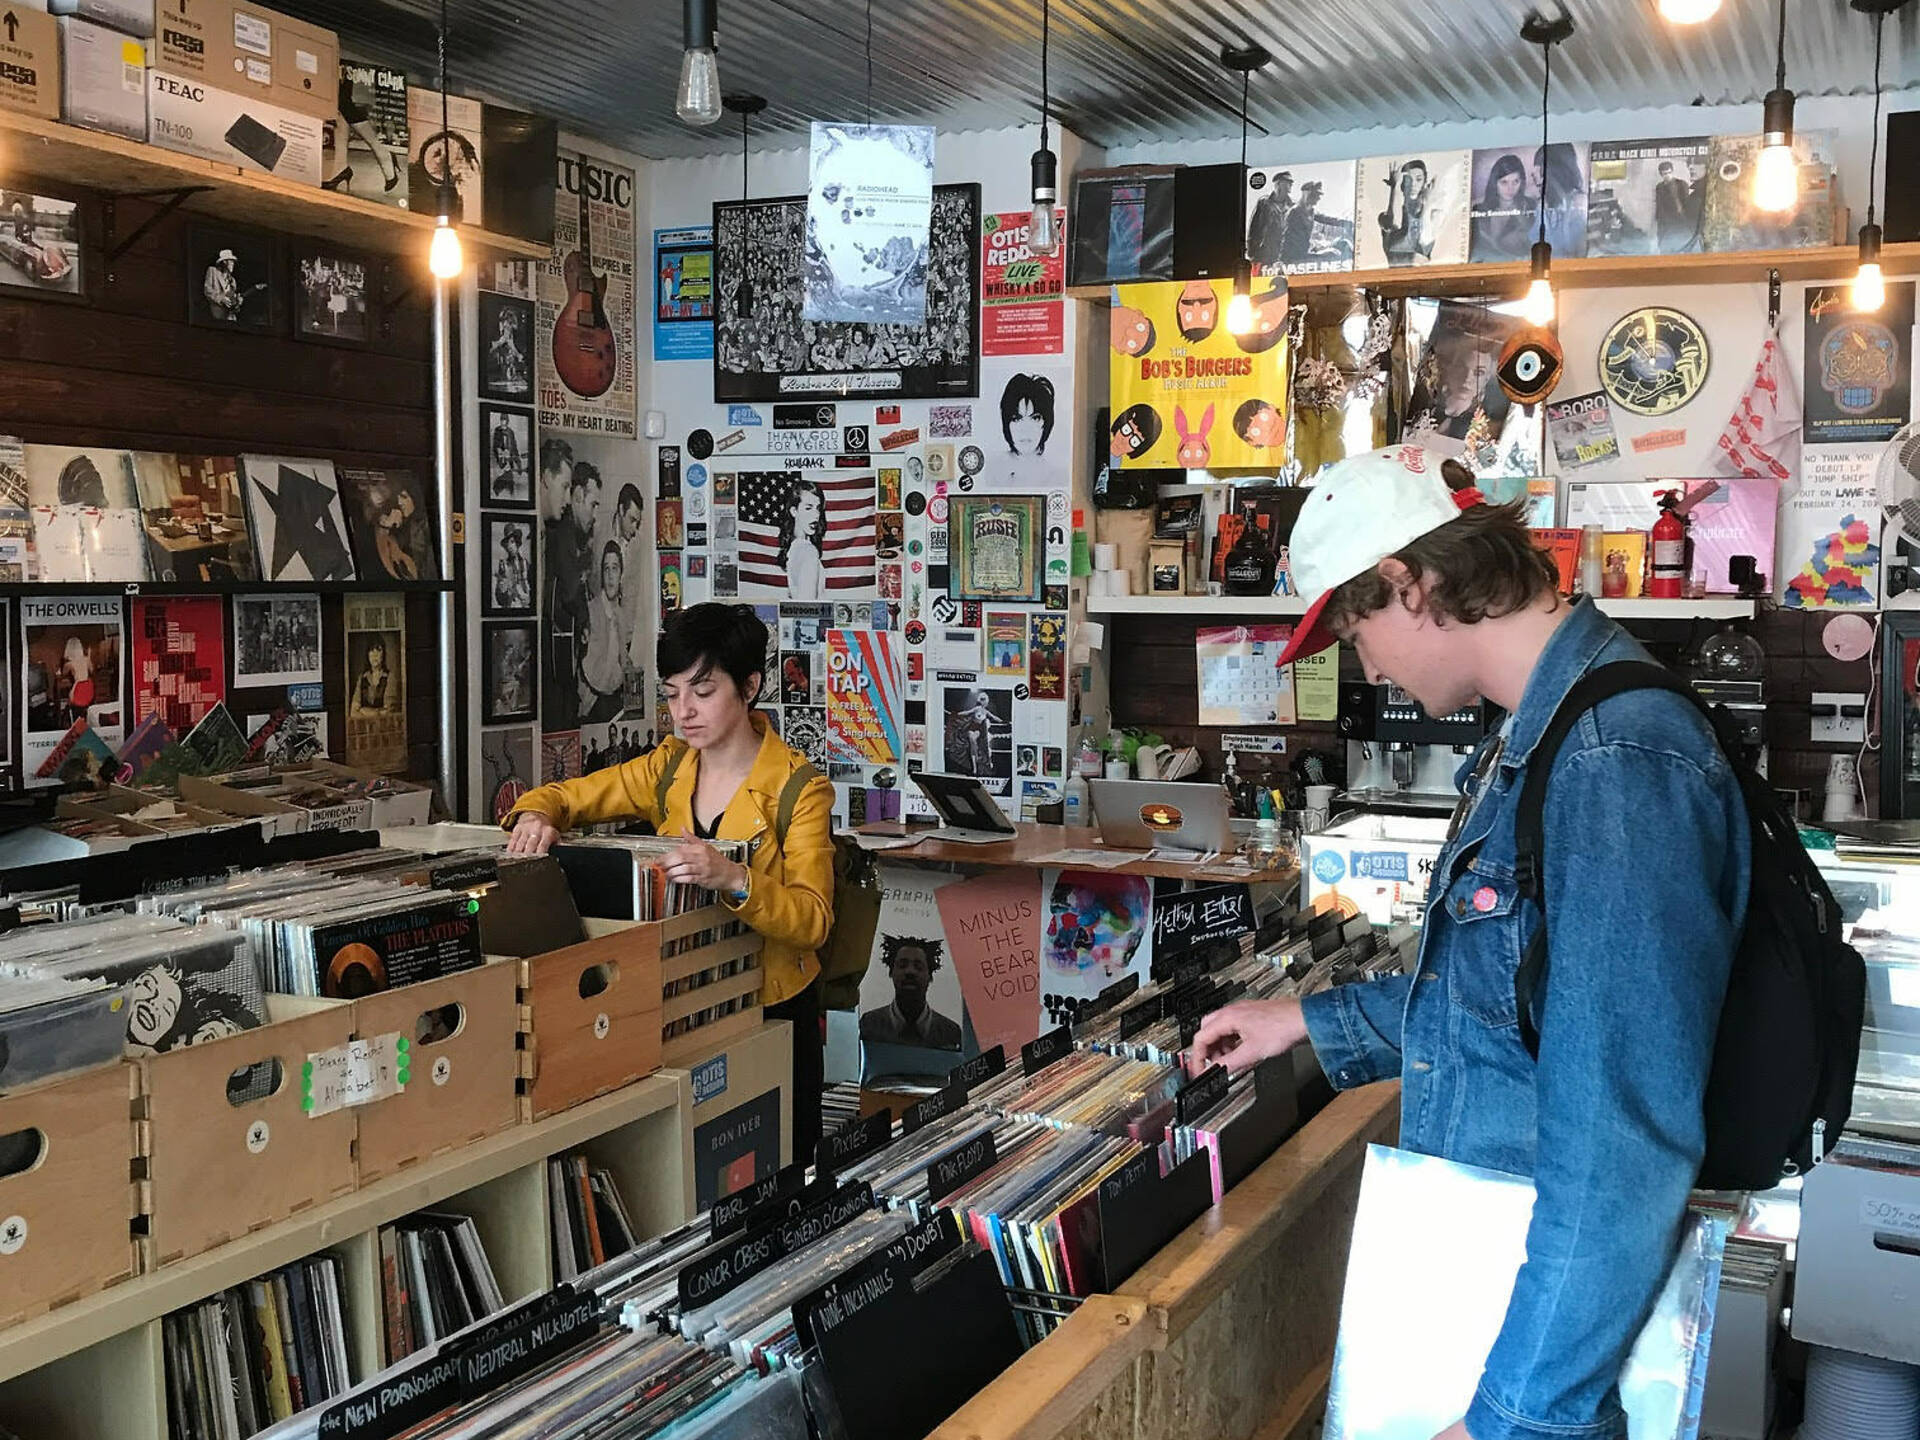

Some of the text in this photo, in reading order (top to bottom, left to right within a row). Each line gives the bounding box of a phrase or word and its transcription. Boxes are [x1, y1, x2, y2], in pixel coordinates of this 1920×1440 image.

[0, 61, 36, 86] ega
[155, 76, 204, 103] TEAC
[155, 118, 193, 140] TN-100
[1619, 149, 1638, 159] BLACK
[557, 157, 631, 208] USIC
[991, 225, 1030, 248] OTIS
[1008, 264, 1040, 278] LIVE
[1261, 262, 1280, 276] for
[1283, 261, 1351, 275] VASELINES
[986, 281, 1022, 297] WHISKY
[624, 351, 632, 393] WORLD
[1186, 356, 1252, 379] BURGERS
[540, 389, 567, 410] TOES
[563, 413, 577, 428] MY
[578, 416, 603, 433] HEART
[605, 418, 633, 434] BEATING
[768, 430, 838, 442] THANK GOD
[768, 442, 791, 451] FOR
[1804, 453, 1874, 463] NO THANK YOU
[1815, 465, 1844, 473] DEBUT
[1794, 501, 1835, 509] FEBRUARY
[975, 519, 1018, 540] RUSH
[25, 603, 119, 617] THE ORWELLS
[829, 651, 863, 672] ON
[829, 674, 870, 694] TAP
[841, 702, 860, 711] FREE
[1373, 855, 1406, 869] OTIS
[882, 888, 934, 903] SAMPH
[959, 900, 1033, 936] MINUS
[1200, 894, 1243, 923] Ethel
[386, 918, 470, 950] THE PLATTERS
[979, 926, 1025, 952] THE
[980, 949, 1038, 979] BEAR
[702, 1061, 724, 1085] OTIS
[918, 1094, 945, 1123] PHISH
[712, 1114, 760, 1152] BON IVER
[833, 1123, 868, 1158] PIXIES
[714, 1176, 778, 1228] PEARL JAM
[823, 1190, 868, 1230] O'CONNOR
[904, 1216, 945, 1261] DOUBT
[687, 1233, 775, 1299] CONOR OBERST
[865, 1267, 894, 1303] NAILS
[467, 1336, 528, 1383] NEUTRAL
[321, 1415, 341, 1433] the
[344, 1402, 377, 1433] NEW
